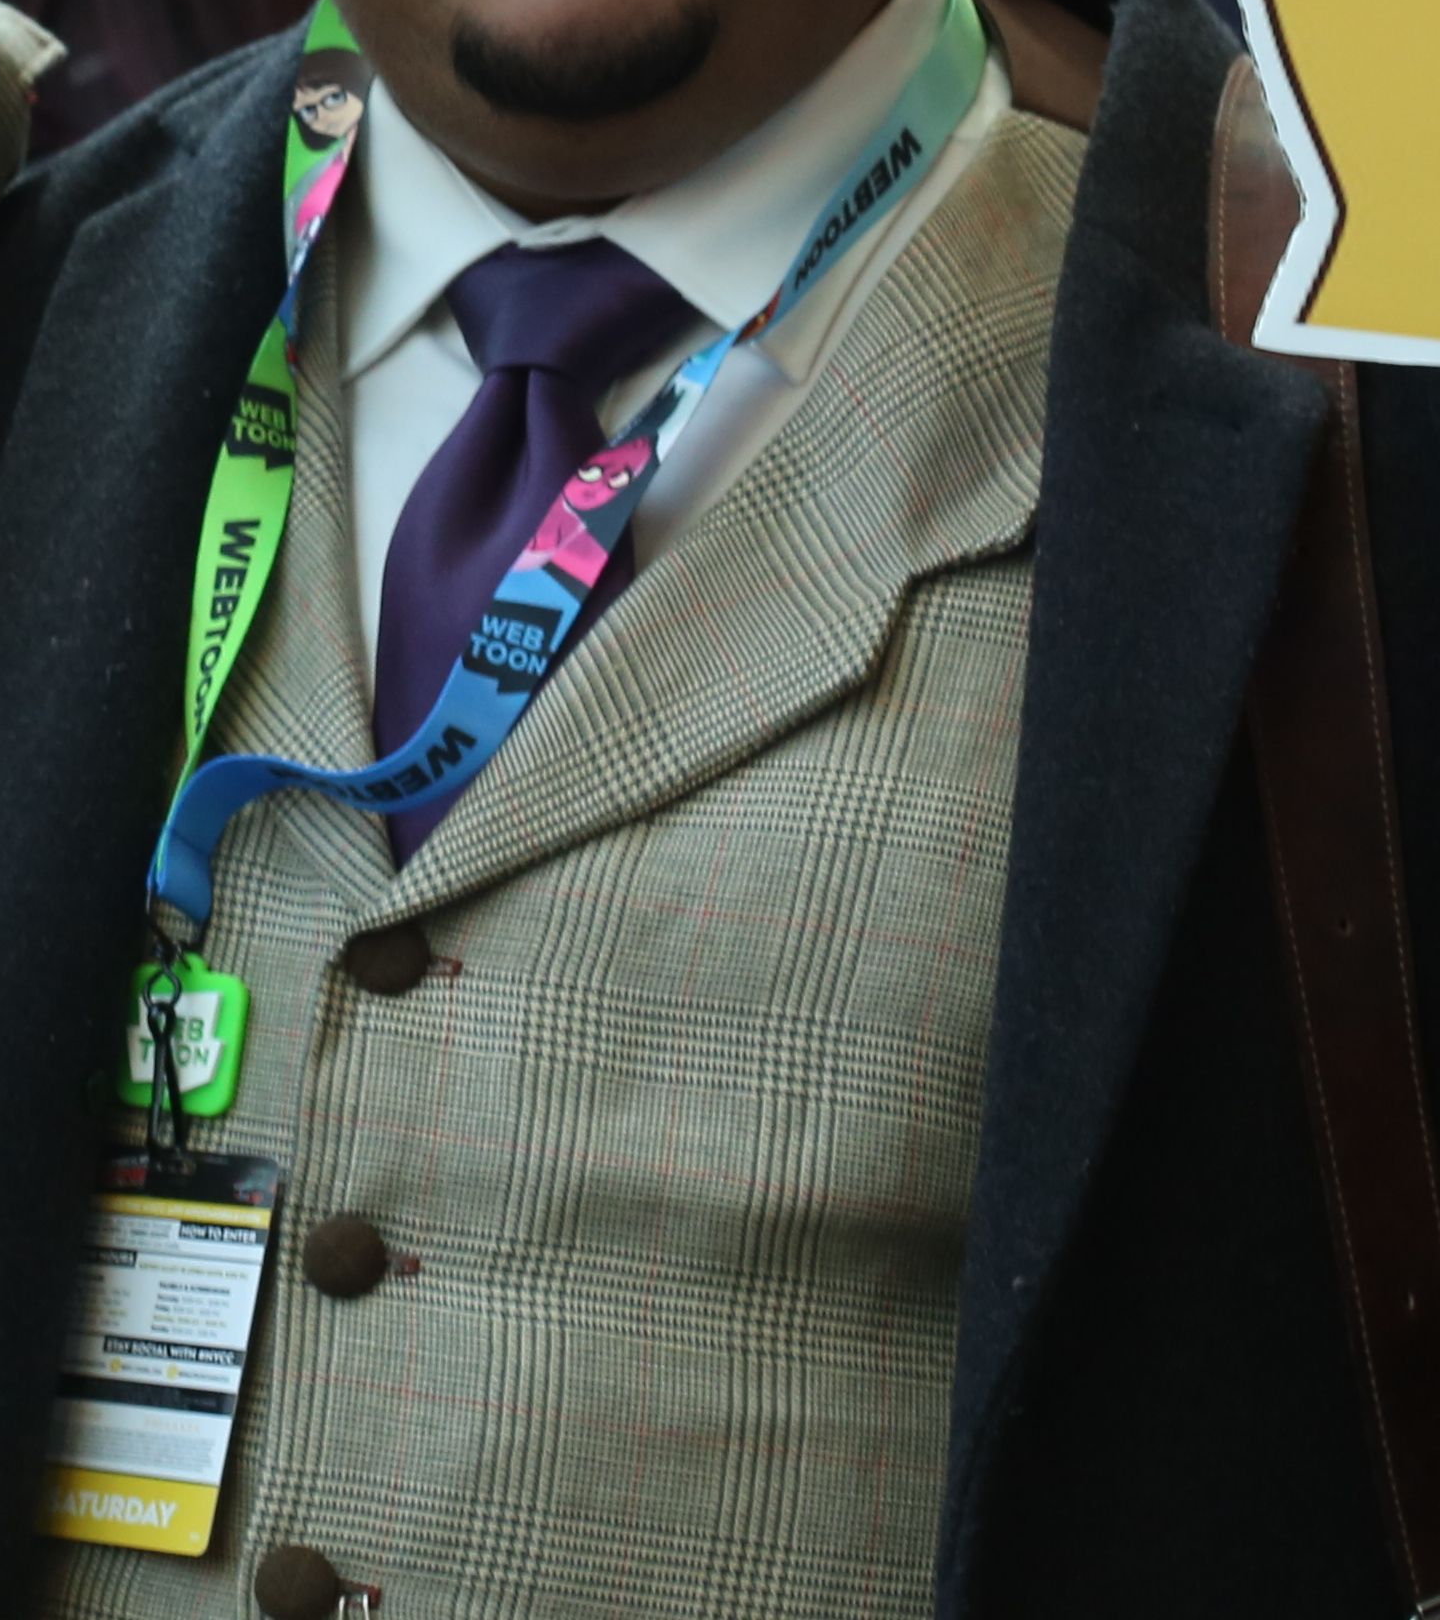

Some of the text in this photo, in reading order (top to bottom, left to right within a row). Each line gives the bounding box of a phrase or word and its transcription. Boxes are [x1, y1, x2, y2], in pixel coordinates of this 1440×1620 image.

[792, 126, 923, 291] WEBTOON
[239, 396, 287, 432] WEB
[194, 518, 262, 736] WEBTOON
[481, 613, 546, 651] WEB
[470, 632, 549, 677] TOON
[138, 1035, 212, 1068] TON
